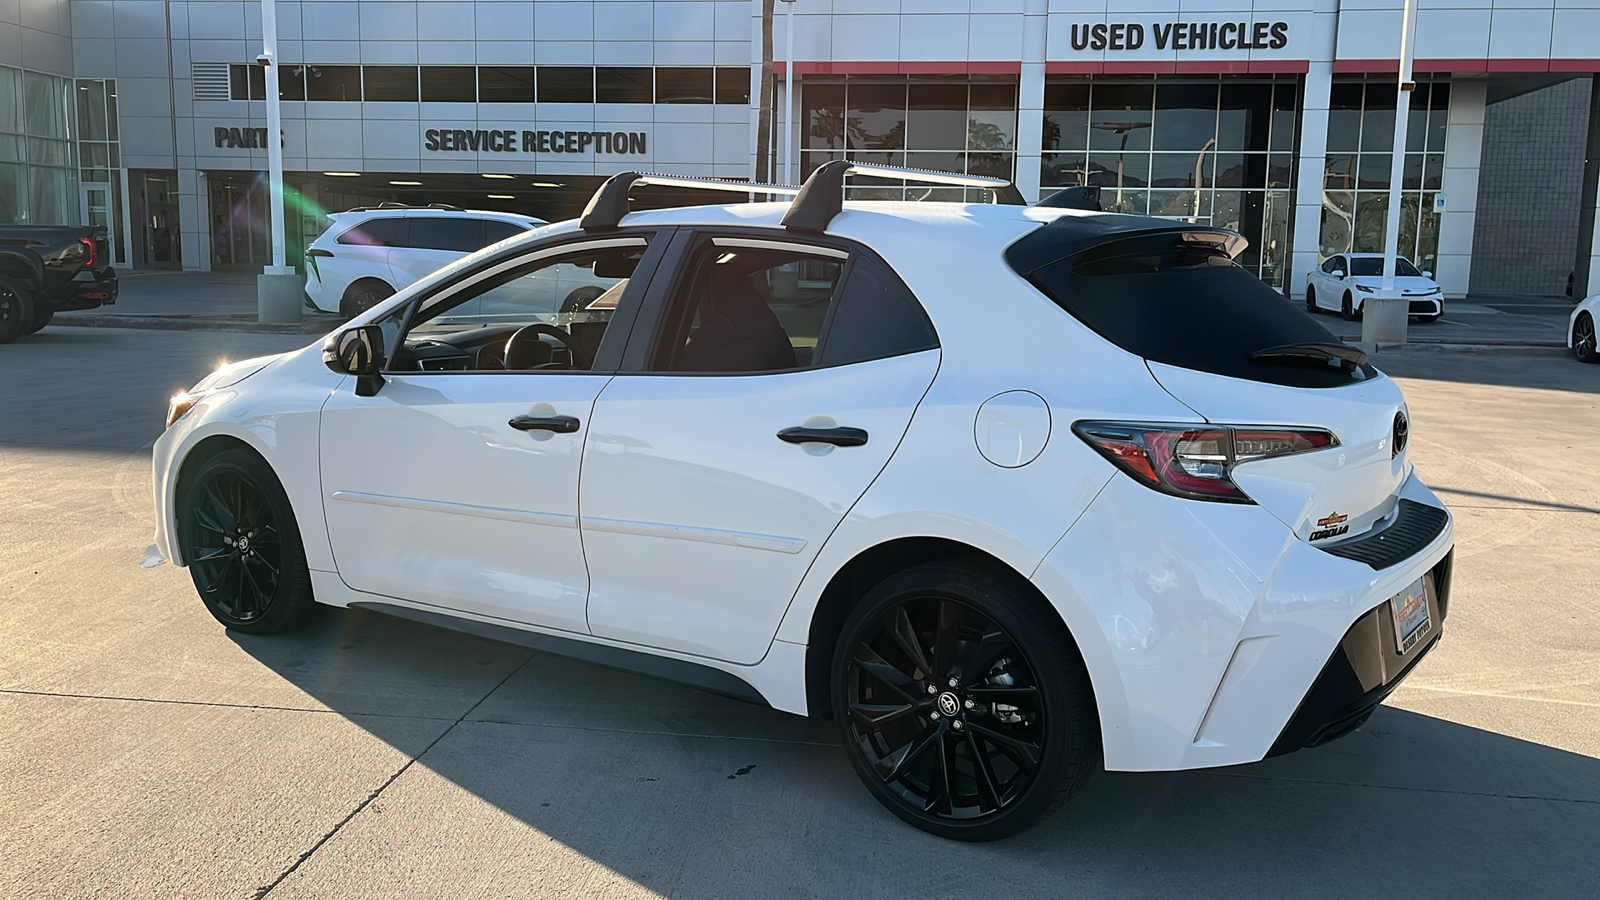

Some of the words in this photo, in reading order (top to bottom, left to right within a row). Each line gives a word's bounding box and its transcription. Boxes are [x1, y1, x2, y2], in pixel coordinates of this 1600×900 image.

[1071, 23, 1145, 51] USED
[1153, 22, 1289, 50] VEHICLES
[214, 126, 284, 149] PART
[425, 129, 517, 152] SERVICE
[522, 130, 647, 154] RECEPTION
[1308, 524, 1349, 542] COROLLA
